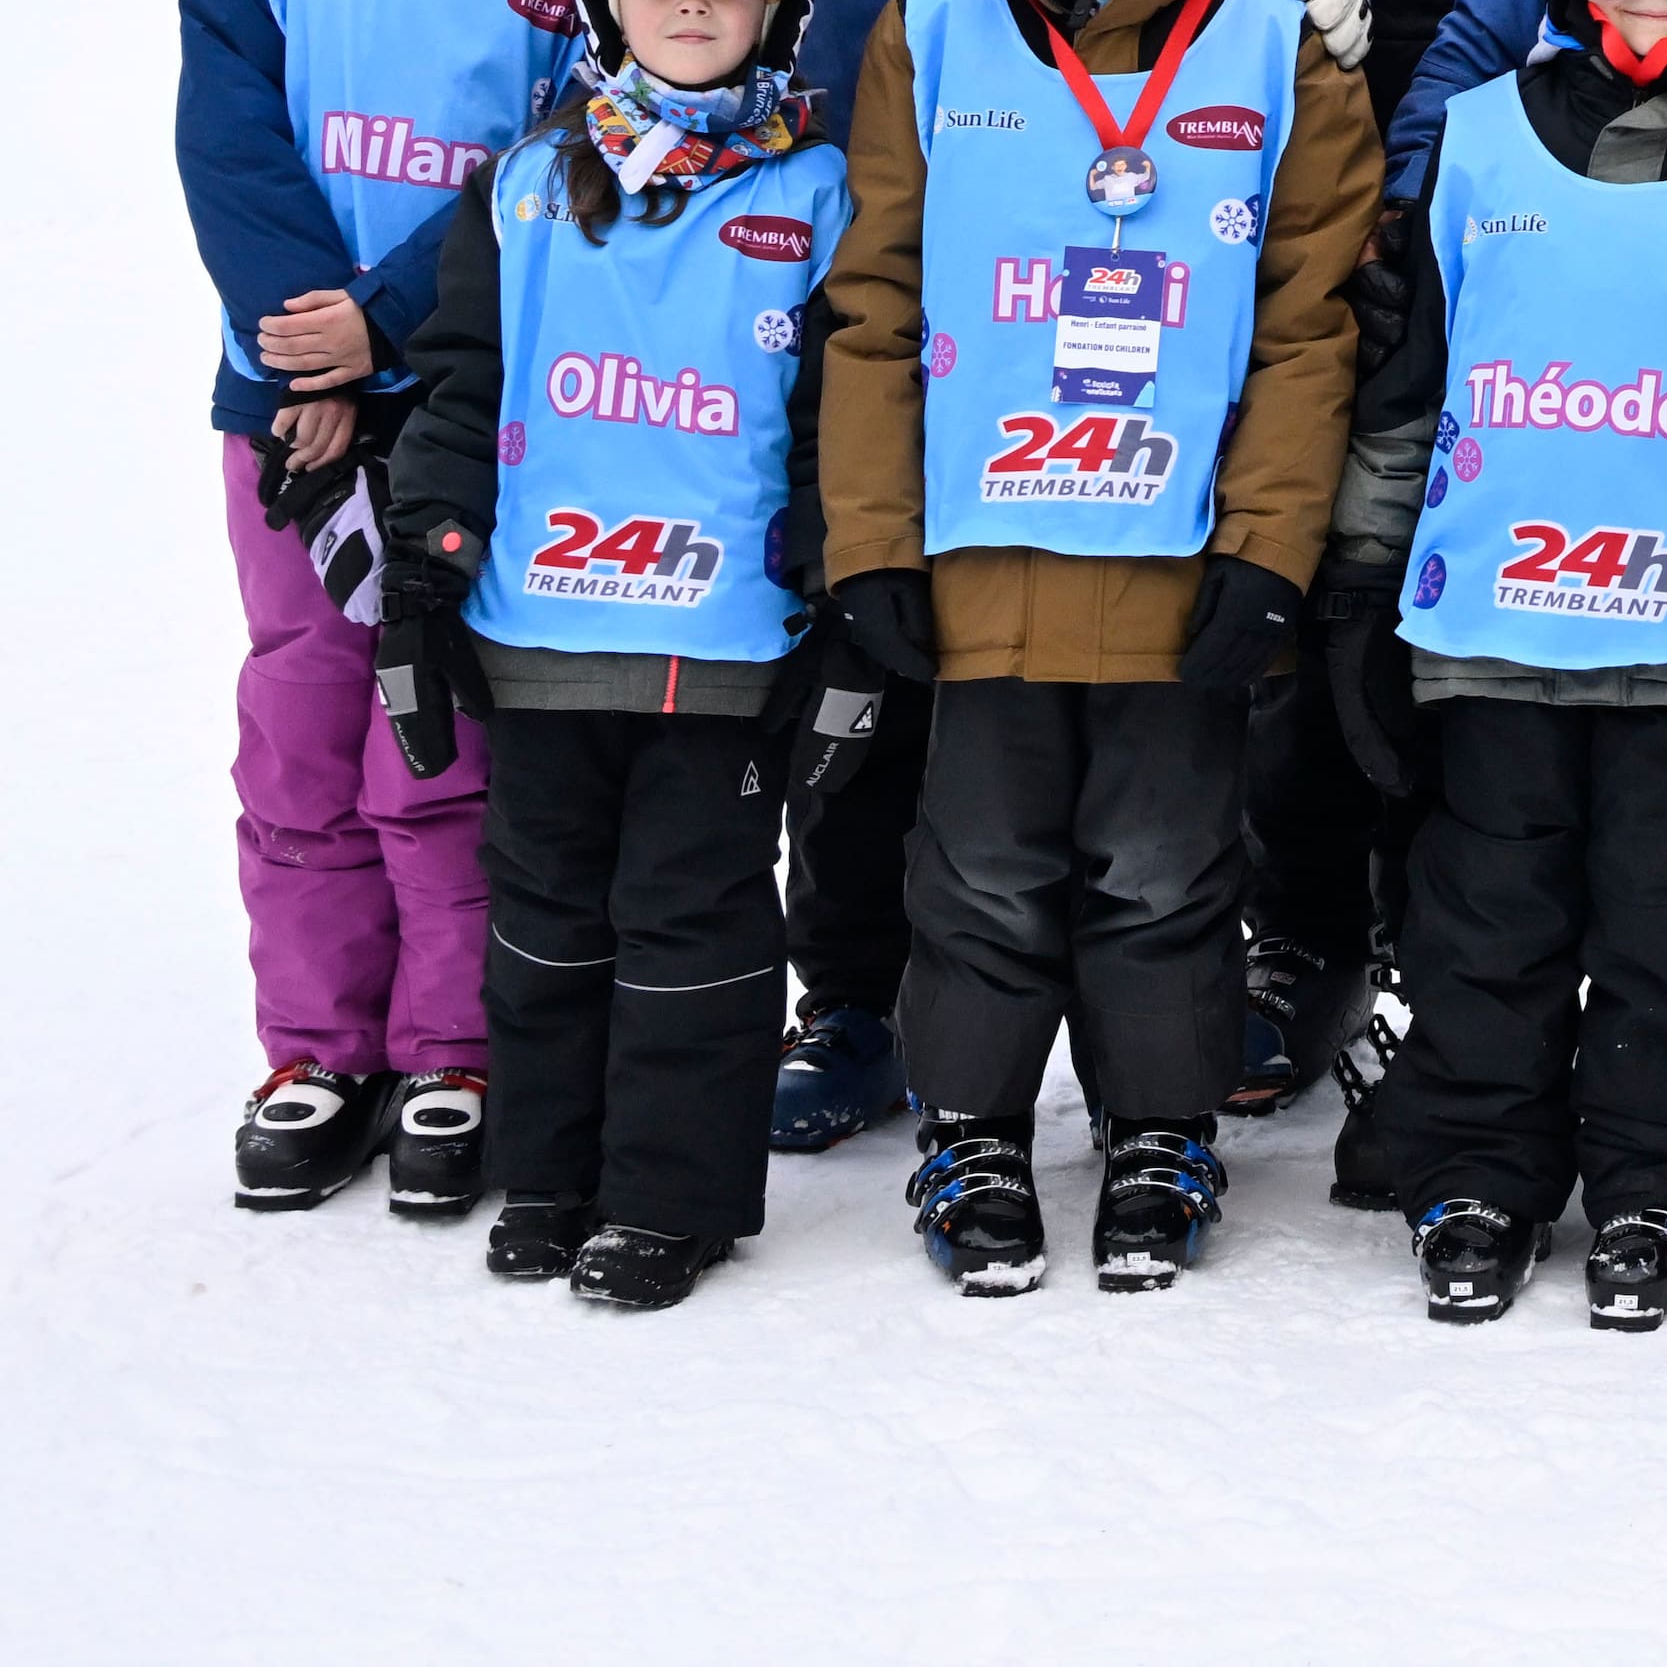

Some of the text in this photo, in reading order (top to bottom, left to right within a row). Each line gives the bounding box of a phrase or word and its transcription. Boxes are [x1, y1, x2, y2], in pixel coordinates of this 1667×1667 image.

[947, 110, 1026, 131] Sun Life
[1179, 120, 1263, 147] TREMBLAN
[1511, 213, 1547, 233] Life
[730, 225, 811, 257] TREMBLAN
[1089, 269, 1141, 285] 24h
[1071, 320, 1090, 328] Henri
[1063, 341, 1150, 354] FONDATION DU CHILDREN
[548, 352, 738, 436] Olivia
[988, 417, 1174, 477] 24h
[984, 478, 1160, 502] TREMBLANT
[533, 513, 718, 583] 24h
[527, 573, 704, 605] TREMBLANT
[806, 742, 840, 787] AUCLAIR
